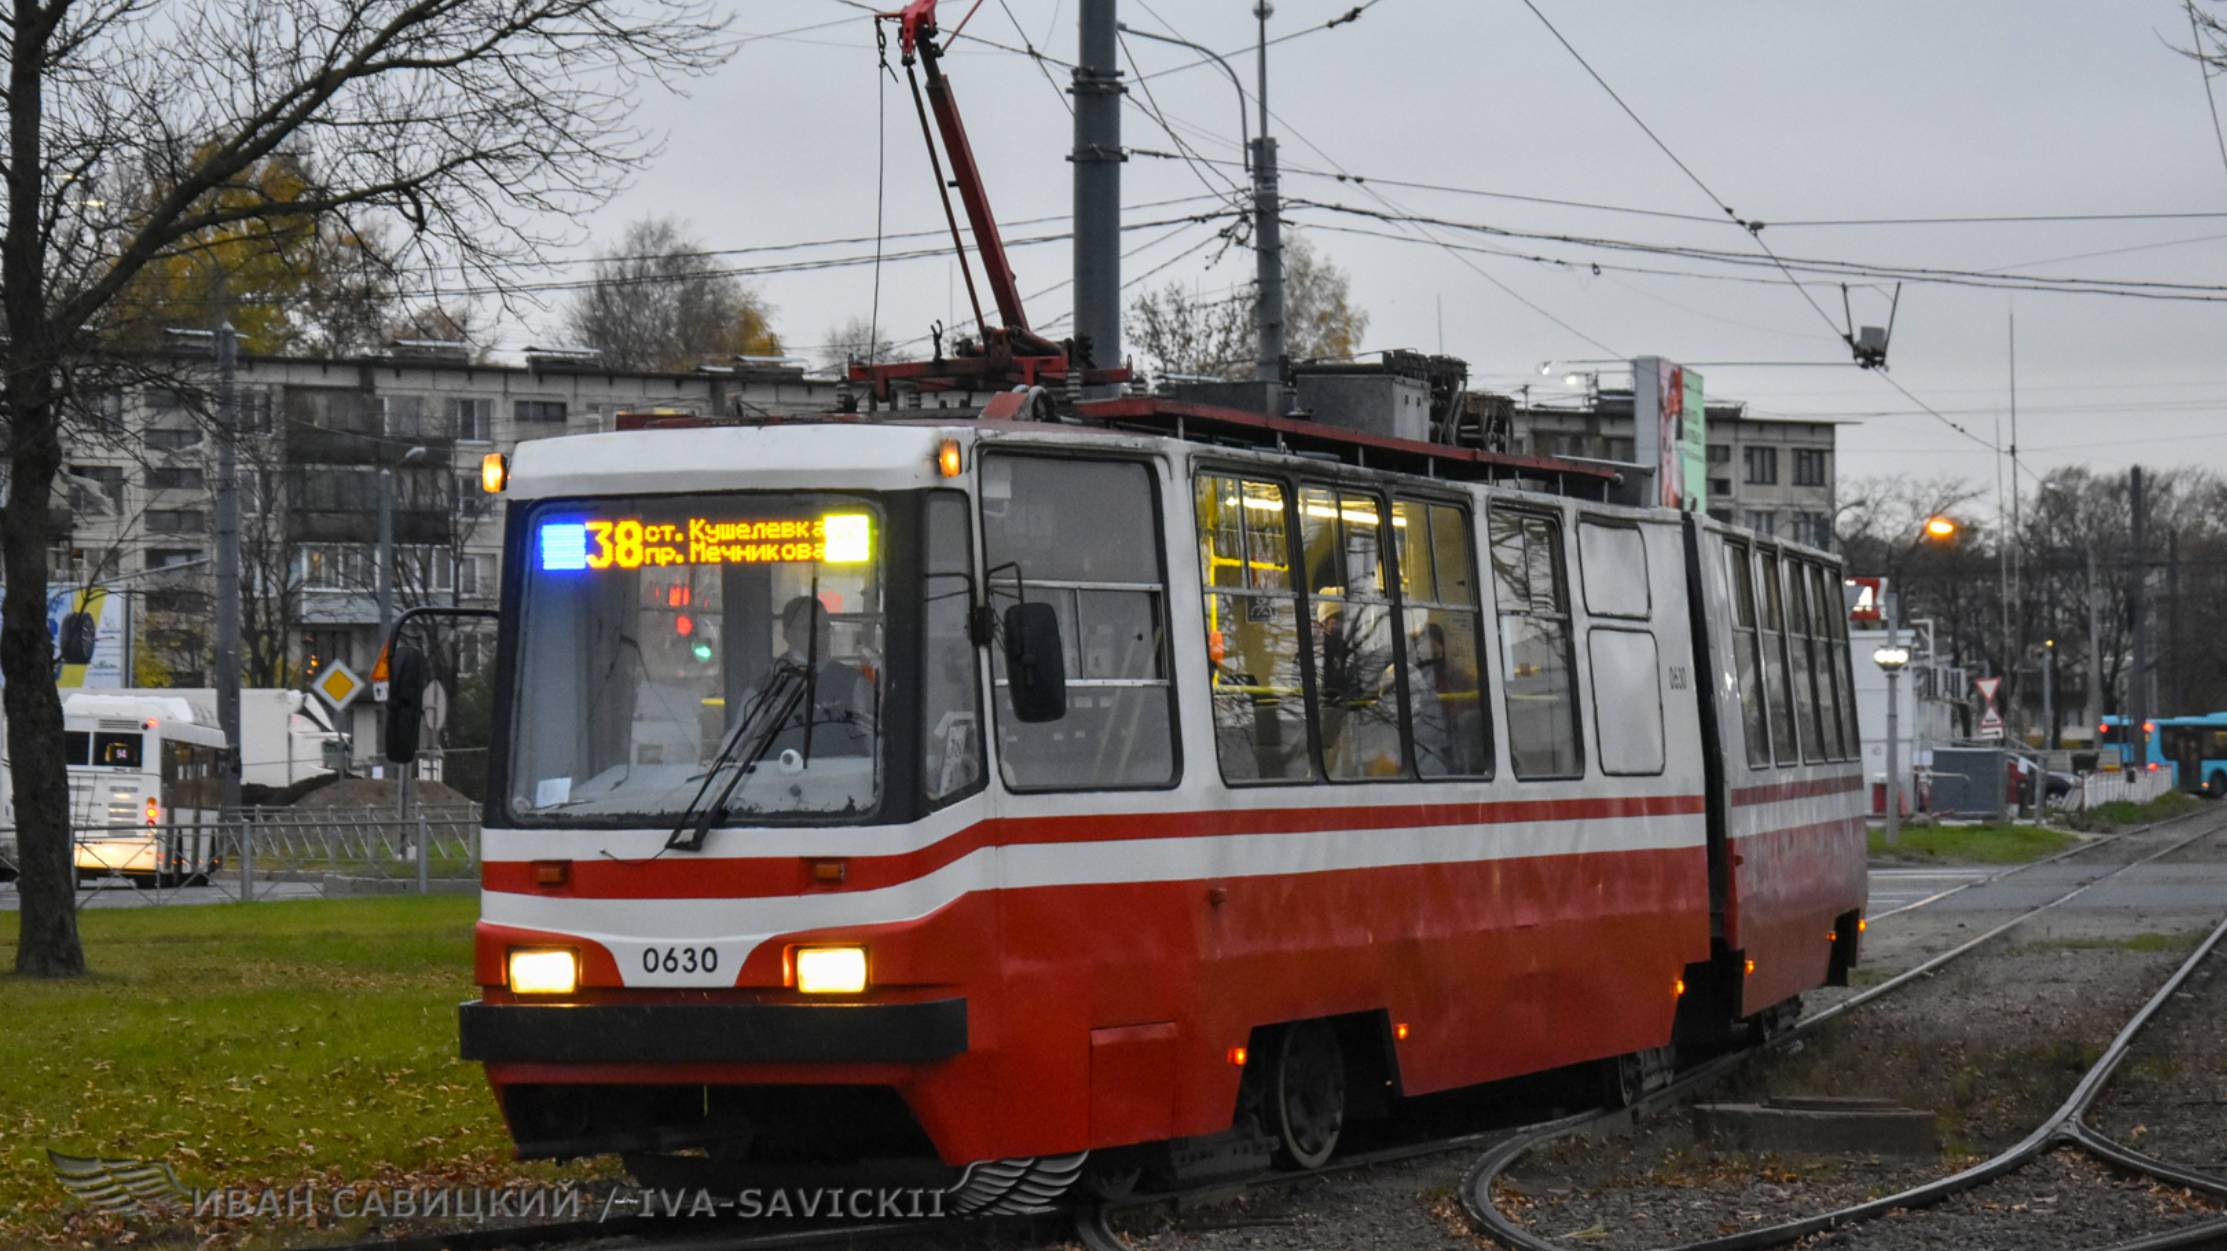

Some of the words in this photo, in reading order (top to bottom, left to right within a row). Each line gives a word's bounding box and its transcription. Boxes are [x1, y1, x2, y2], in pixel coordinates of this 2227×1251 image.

[645, 524, 684, 543] ст.
[689, 517, 826, 542] Кушелевка
[584, 519, 644, 569] 38
[644, 546, 684, 567] пр.
[690, 541, 826, 563] Мечникова
[643, 947, 718, 973] 0630
